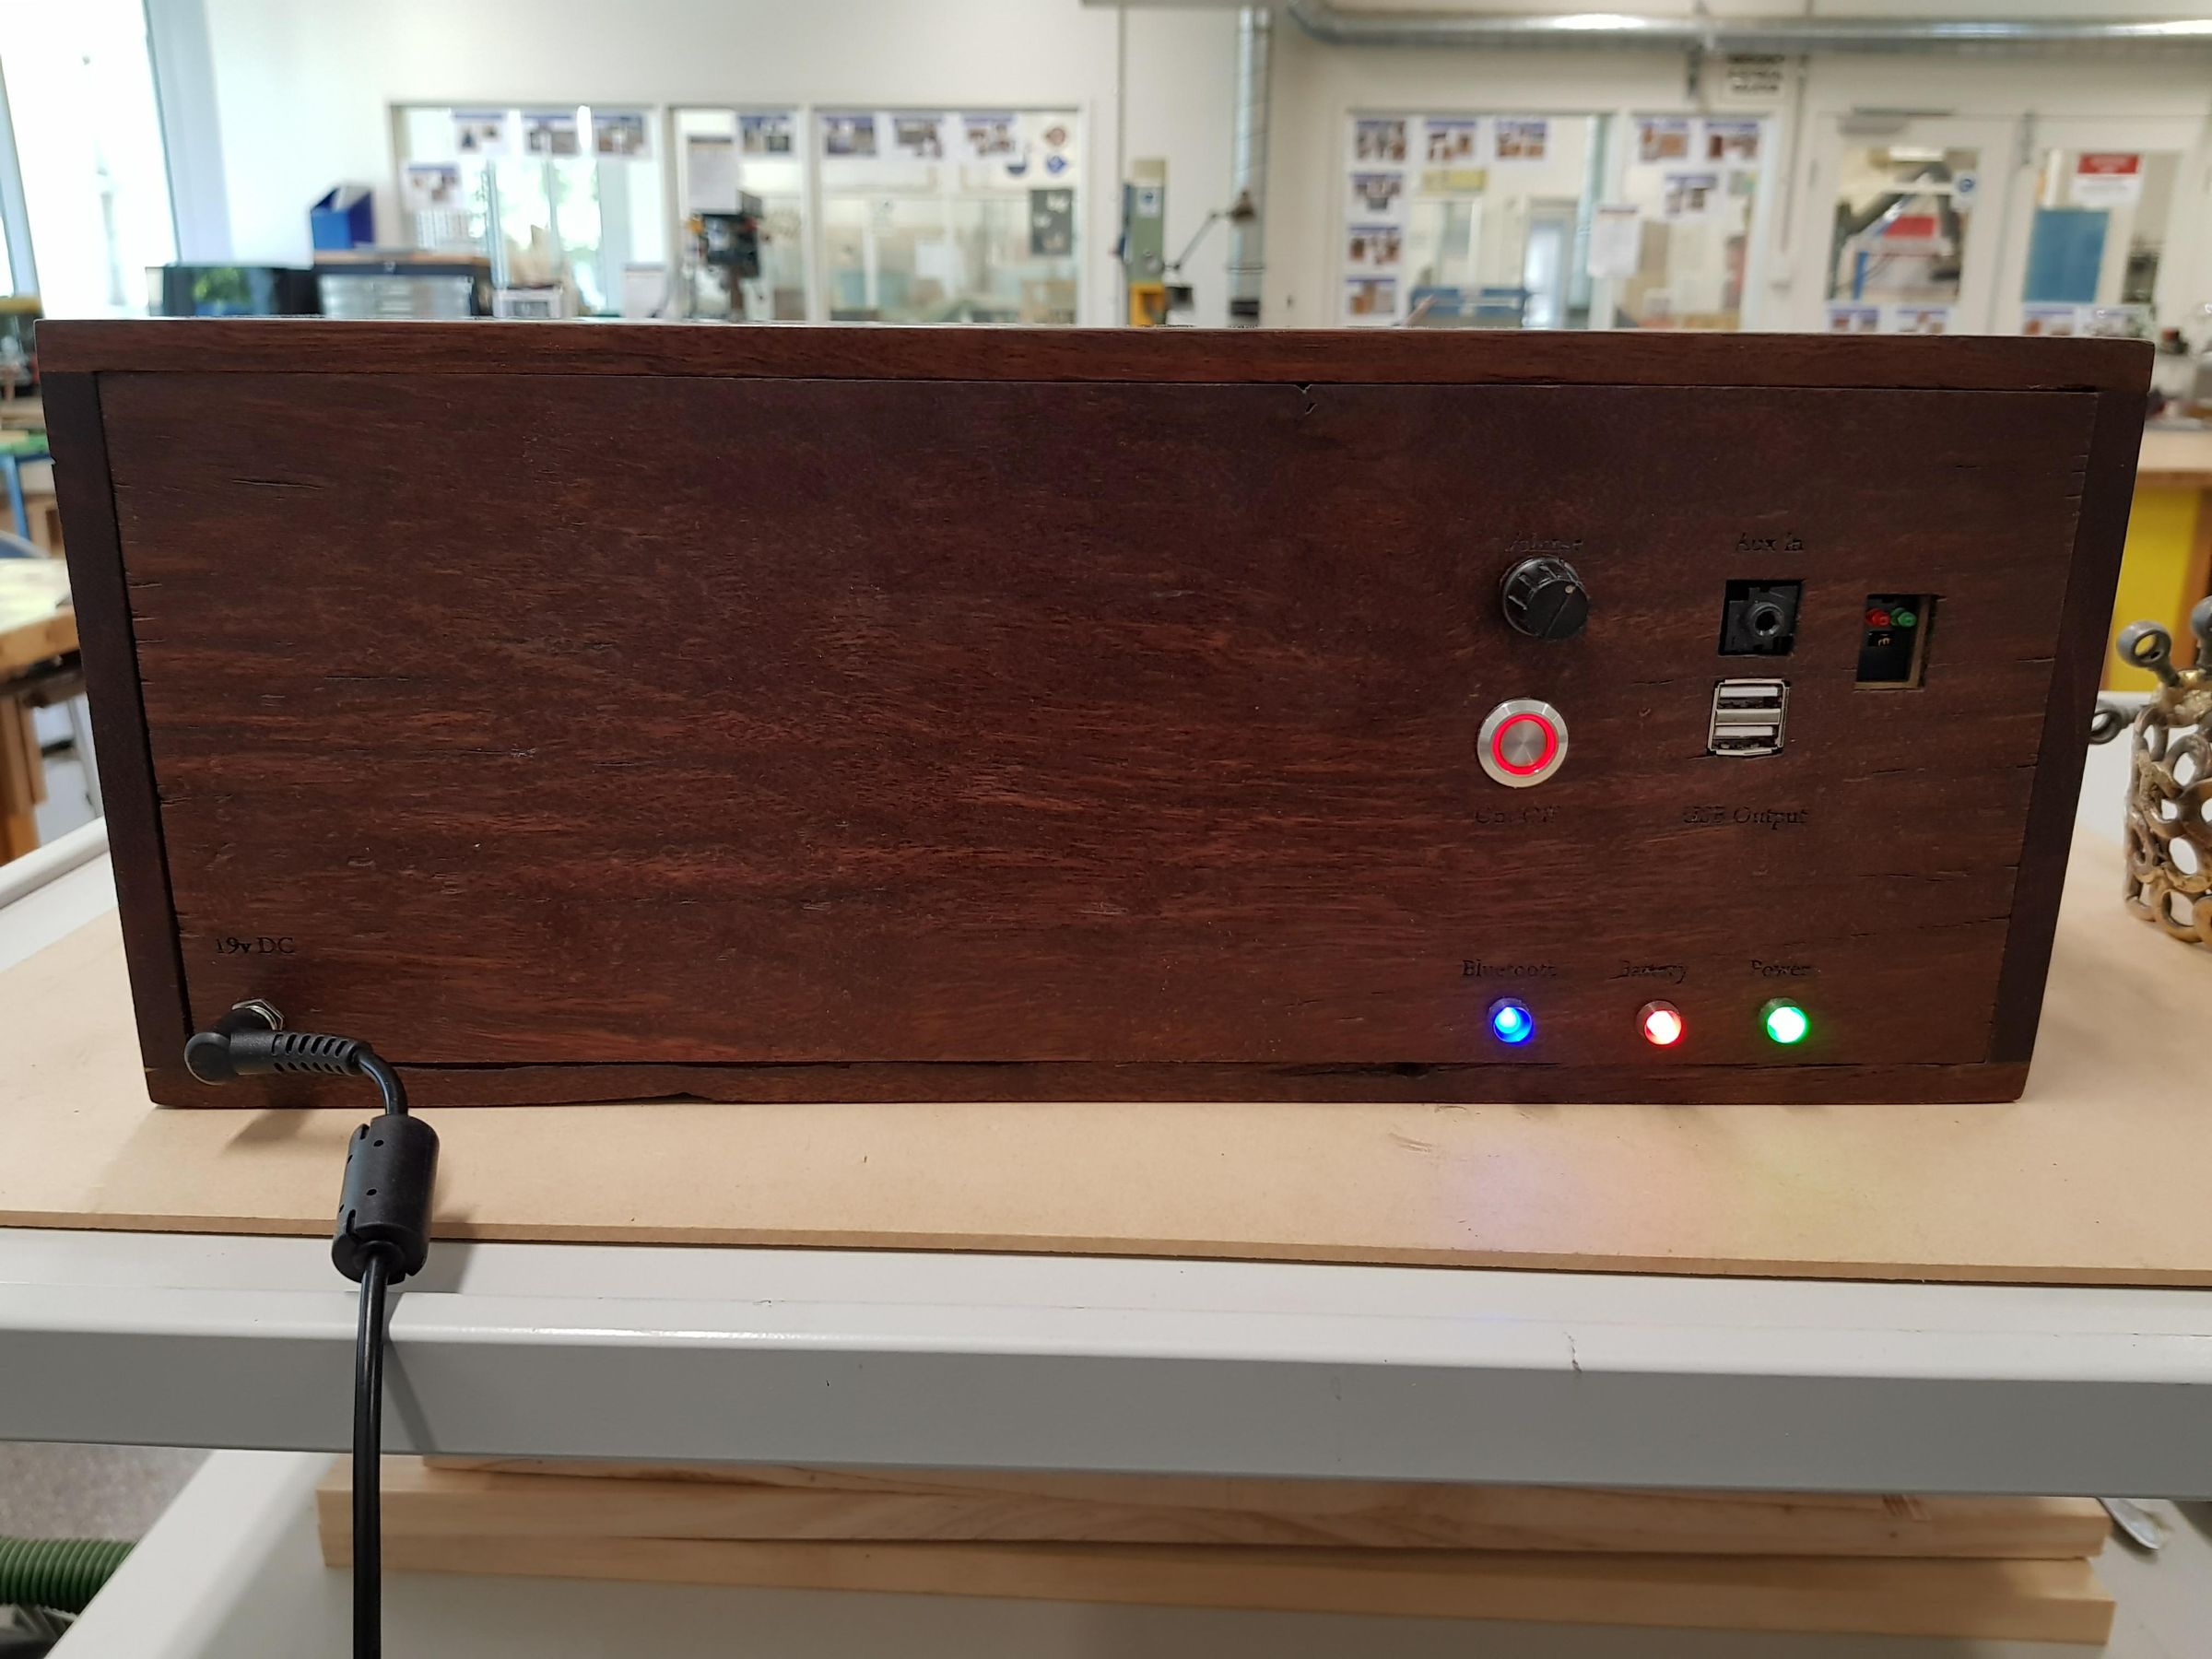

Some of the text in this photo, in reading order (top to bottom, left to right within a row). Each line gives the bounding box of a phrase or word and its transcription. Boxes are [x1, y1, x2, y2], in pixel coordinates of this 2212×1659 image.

[1734, 806, 1808, 830] Output
[256, 936, 295, 954] DC
[1751, 959, 1812, 977] Power
